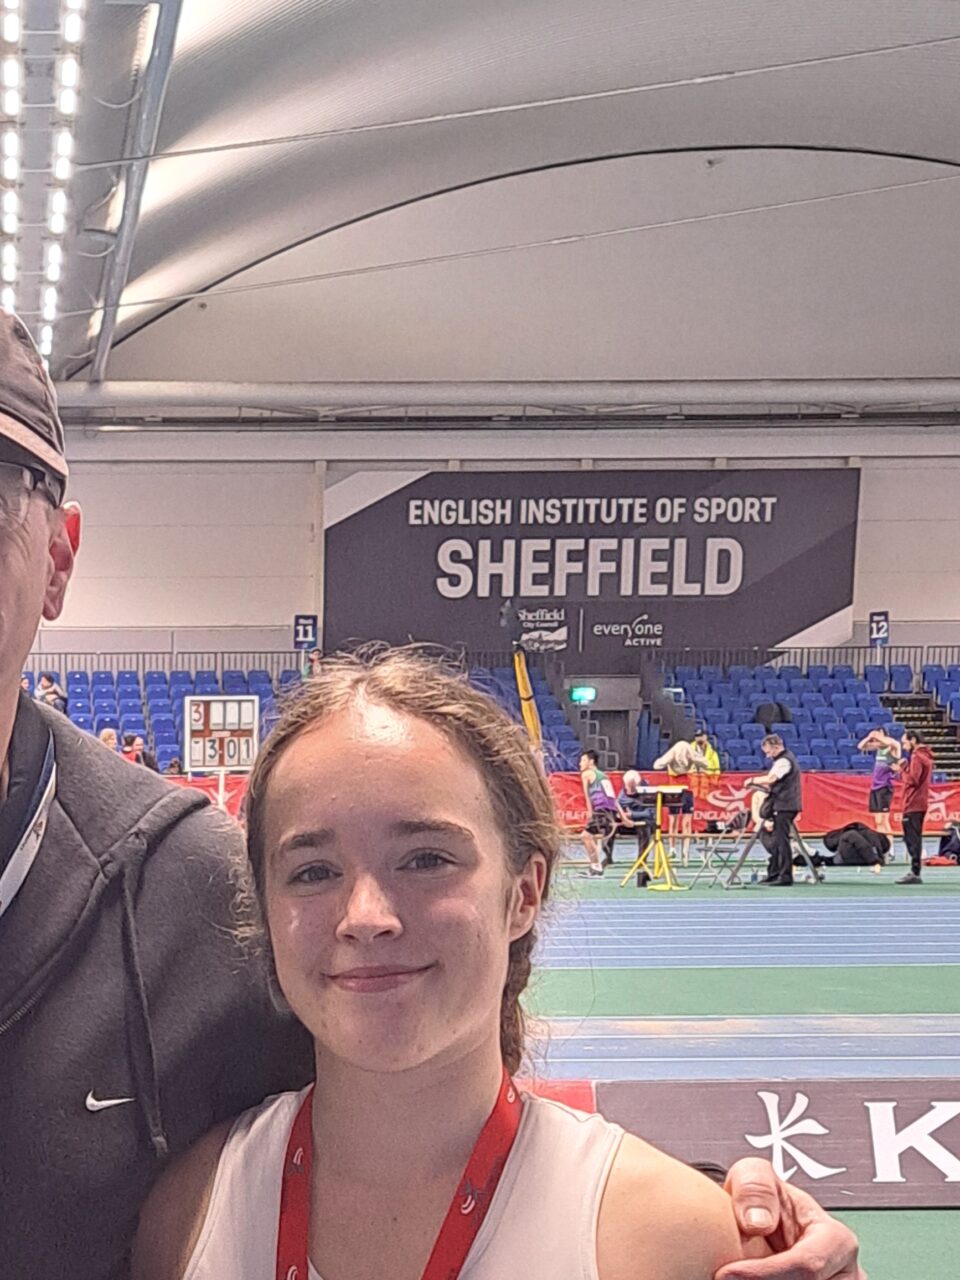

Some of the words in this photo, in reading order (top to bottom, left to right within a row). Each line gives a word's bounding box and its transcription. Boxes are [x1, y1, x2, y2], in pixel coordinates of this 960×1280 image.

[408, 499, 512, 526] ENGLISH
[520, 498, 647, 525] INSTITUTE
[655, 498, 686, 524] OF
[693, 497, 777, 524] SPORT
[436, 537, 744, 599] SHEFFIELD
[296, 625, 315, 641] 11
[593, 614, 663, 638] everyone
[871, 621, 888, 638] 12
[624, 638, 663, 647] ACTIVE
[193, 703, 202, 722] 3
